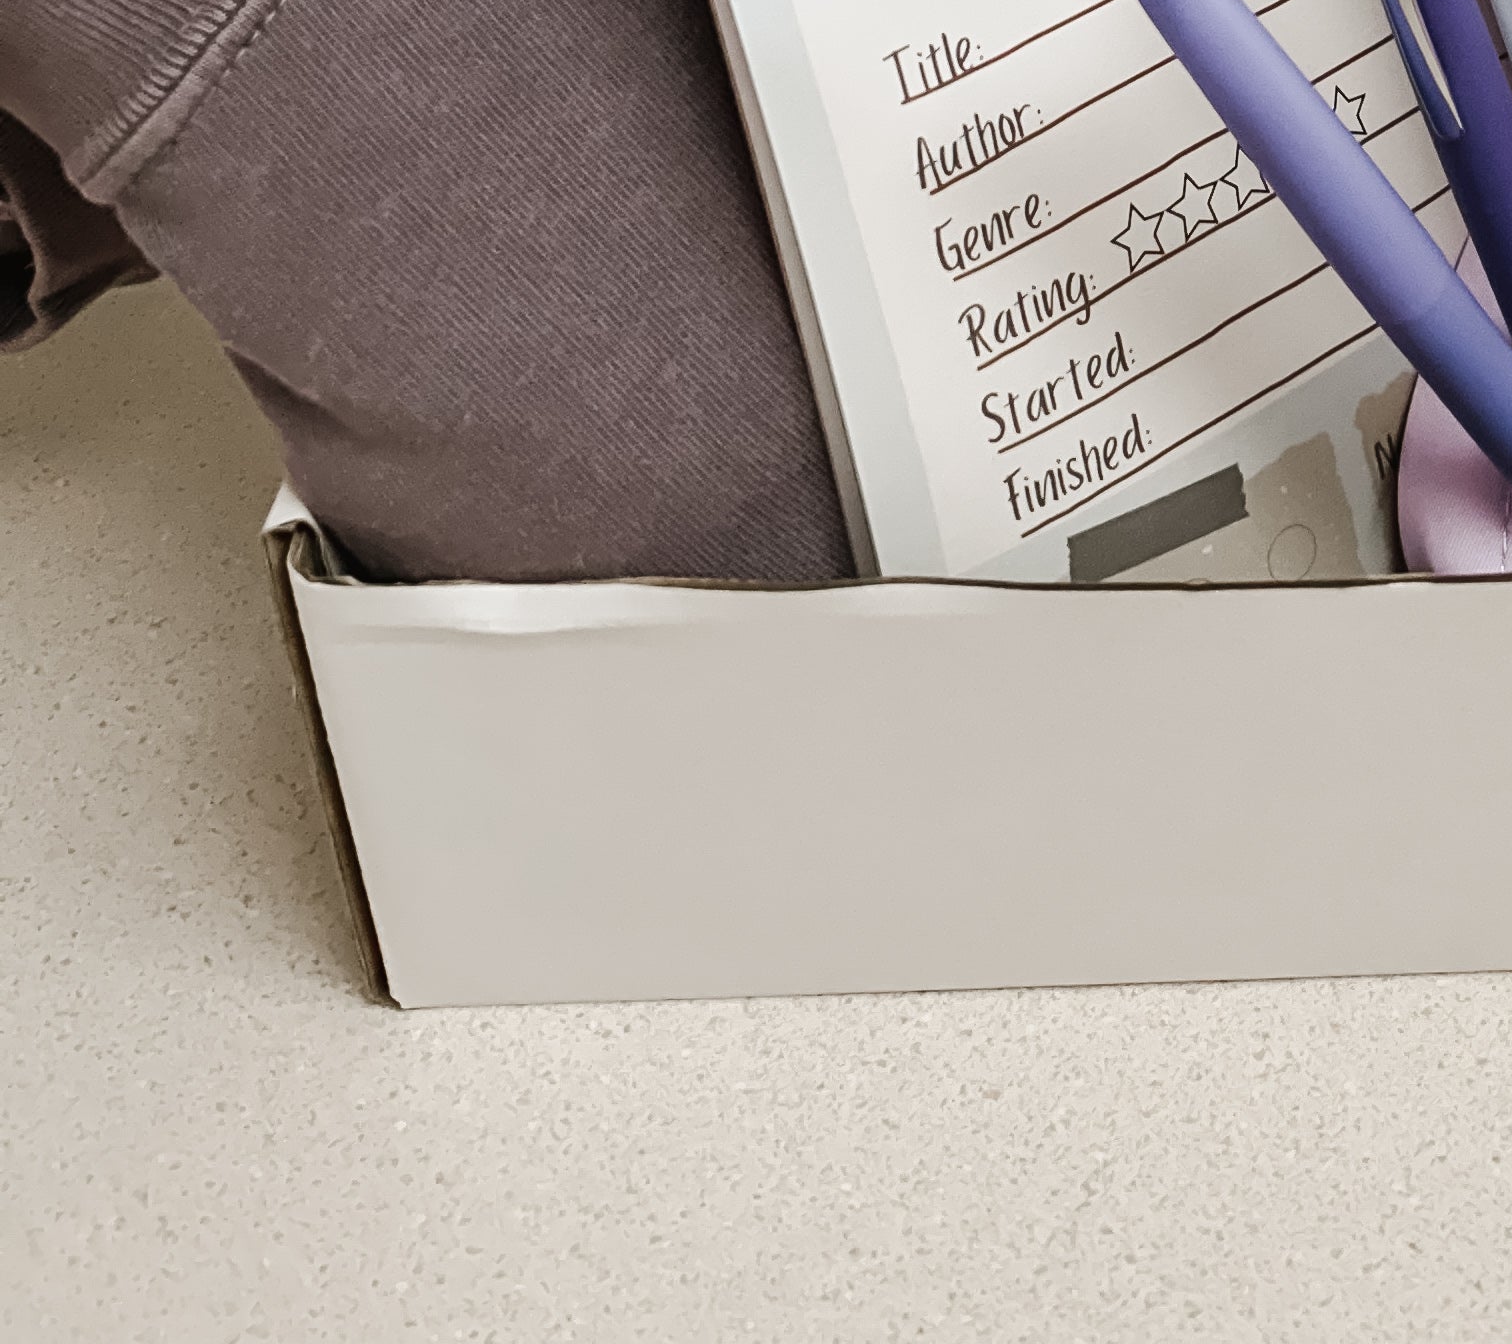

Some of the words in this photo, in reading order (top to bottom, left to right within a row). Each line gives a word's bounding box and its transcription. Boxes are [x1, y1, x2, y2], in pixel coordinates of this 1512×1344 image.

[882, 32, 985, 105] Title:
[915, 103, 1045, 189] Author:
[934, 191, 1053, 274] Genre:
[957, 269, 1097, 357] Rating:
[979, 332, 1136, 443] Started:
[1002, 413, 1152, 521] Finished:
